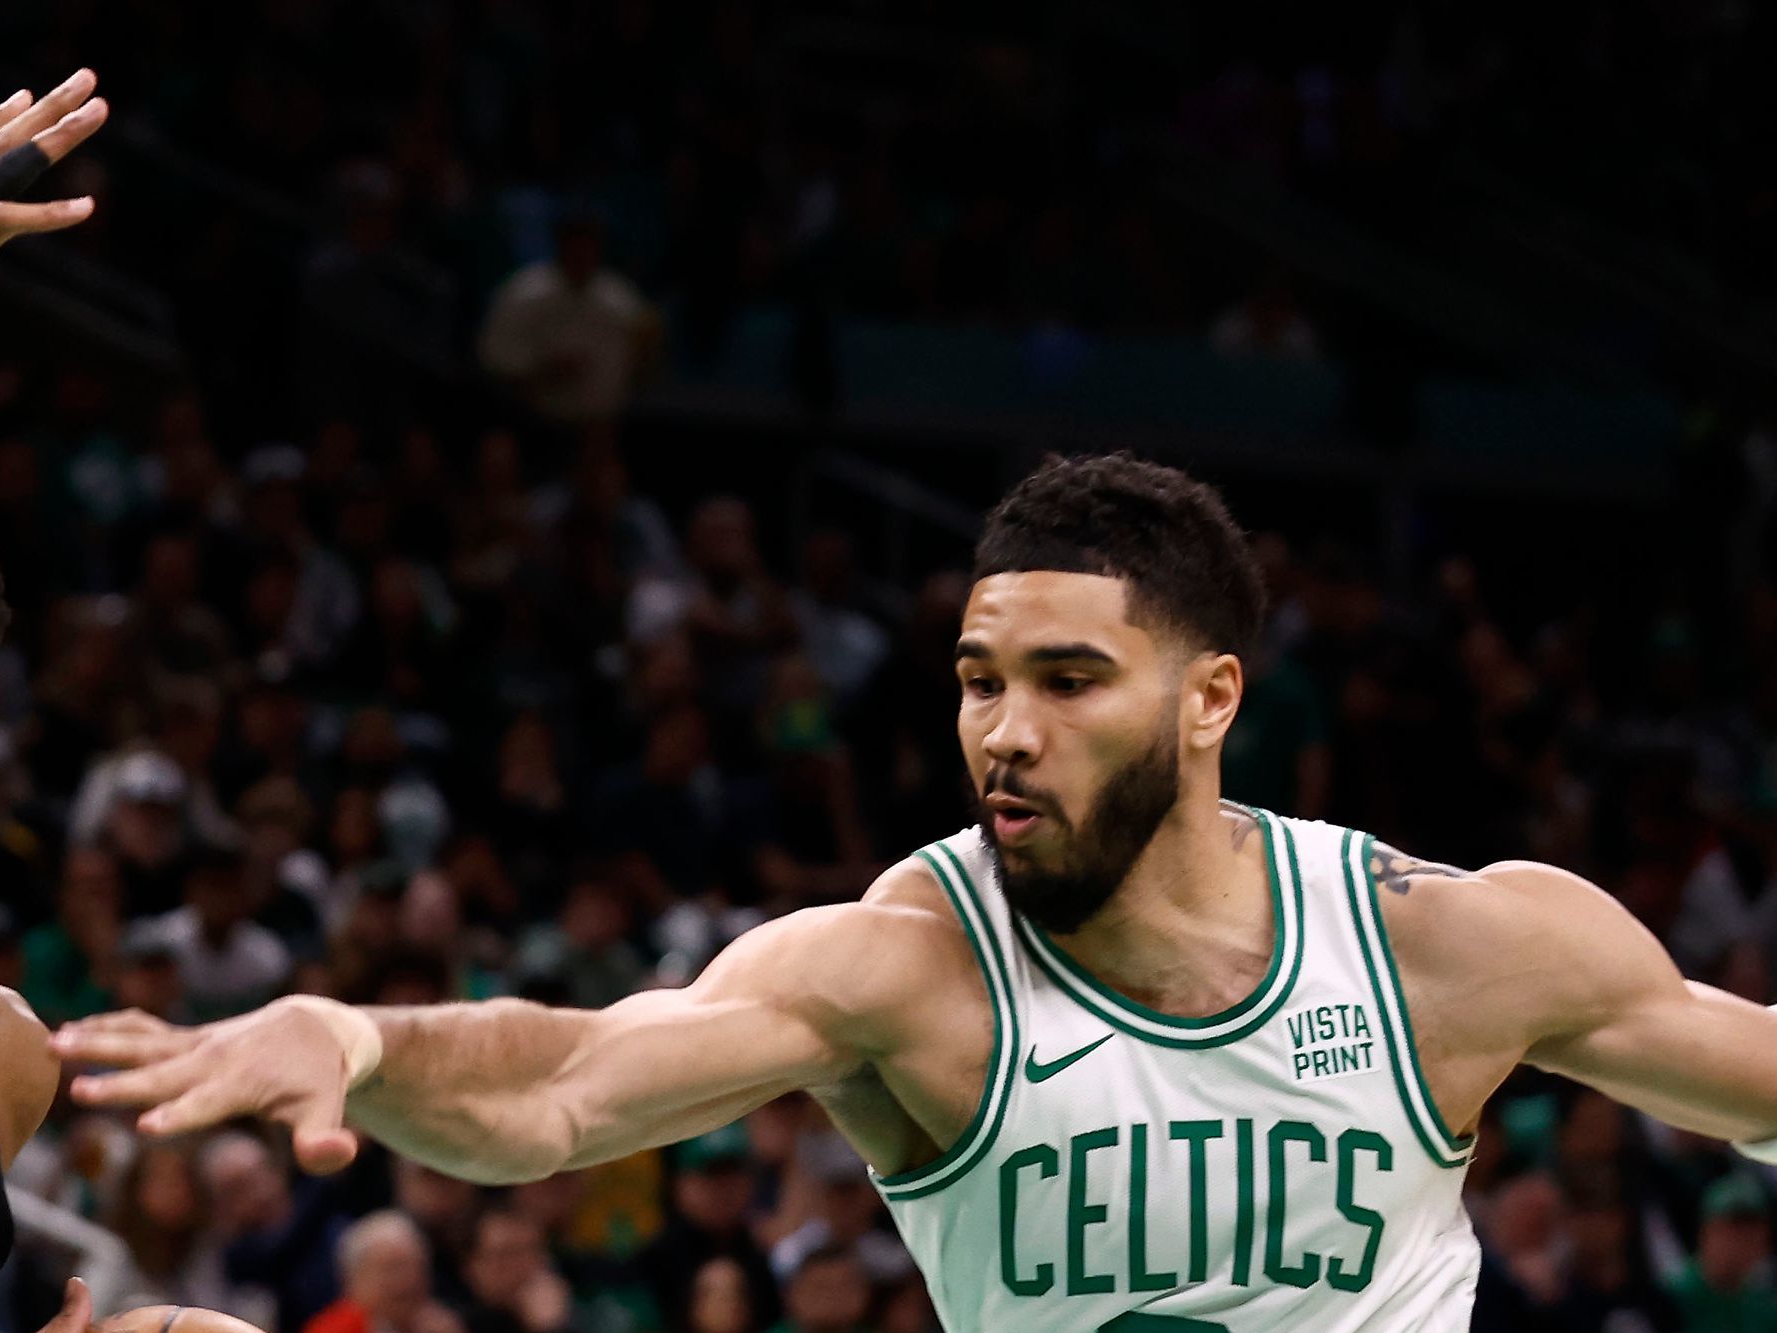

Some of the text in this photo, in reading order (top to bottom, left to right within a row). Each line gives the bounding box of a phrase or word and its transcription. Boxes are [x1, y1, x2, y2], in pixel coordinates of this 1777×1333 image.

[1286, 1004, 1372, 1049] VISTA
[1294, 1041, 1373, 1080] PRINT
[998, 1117, 1394, 1298] CELTICS
